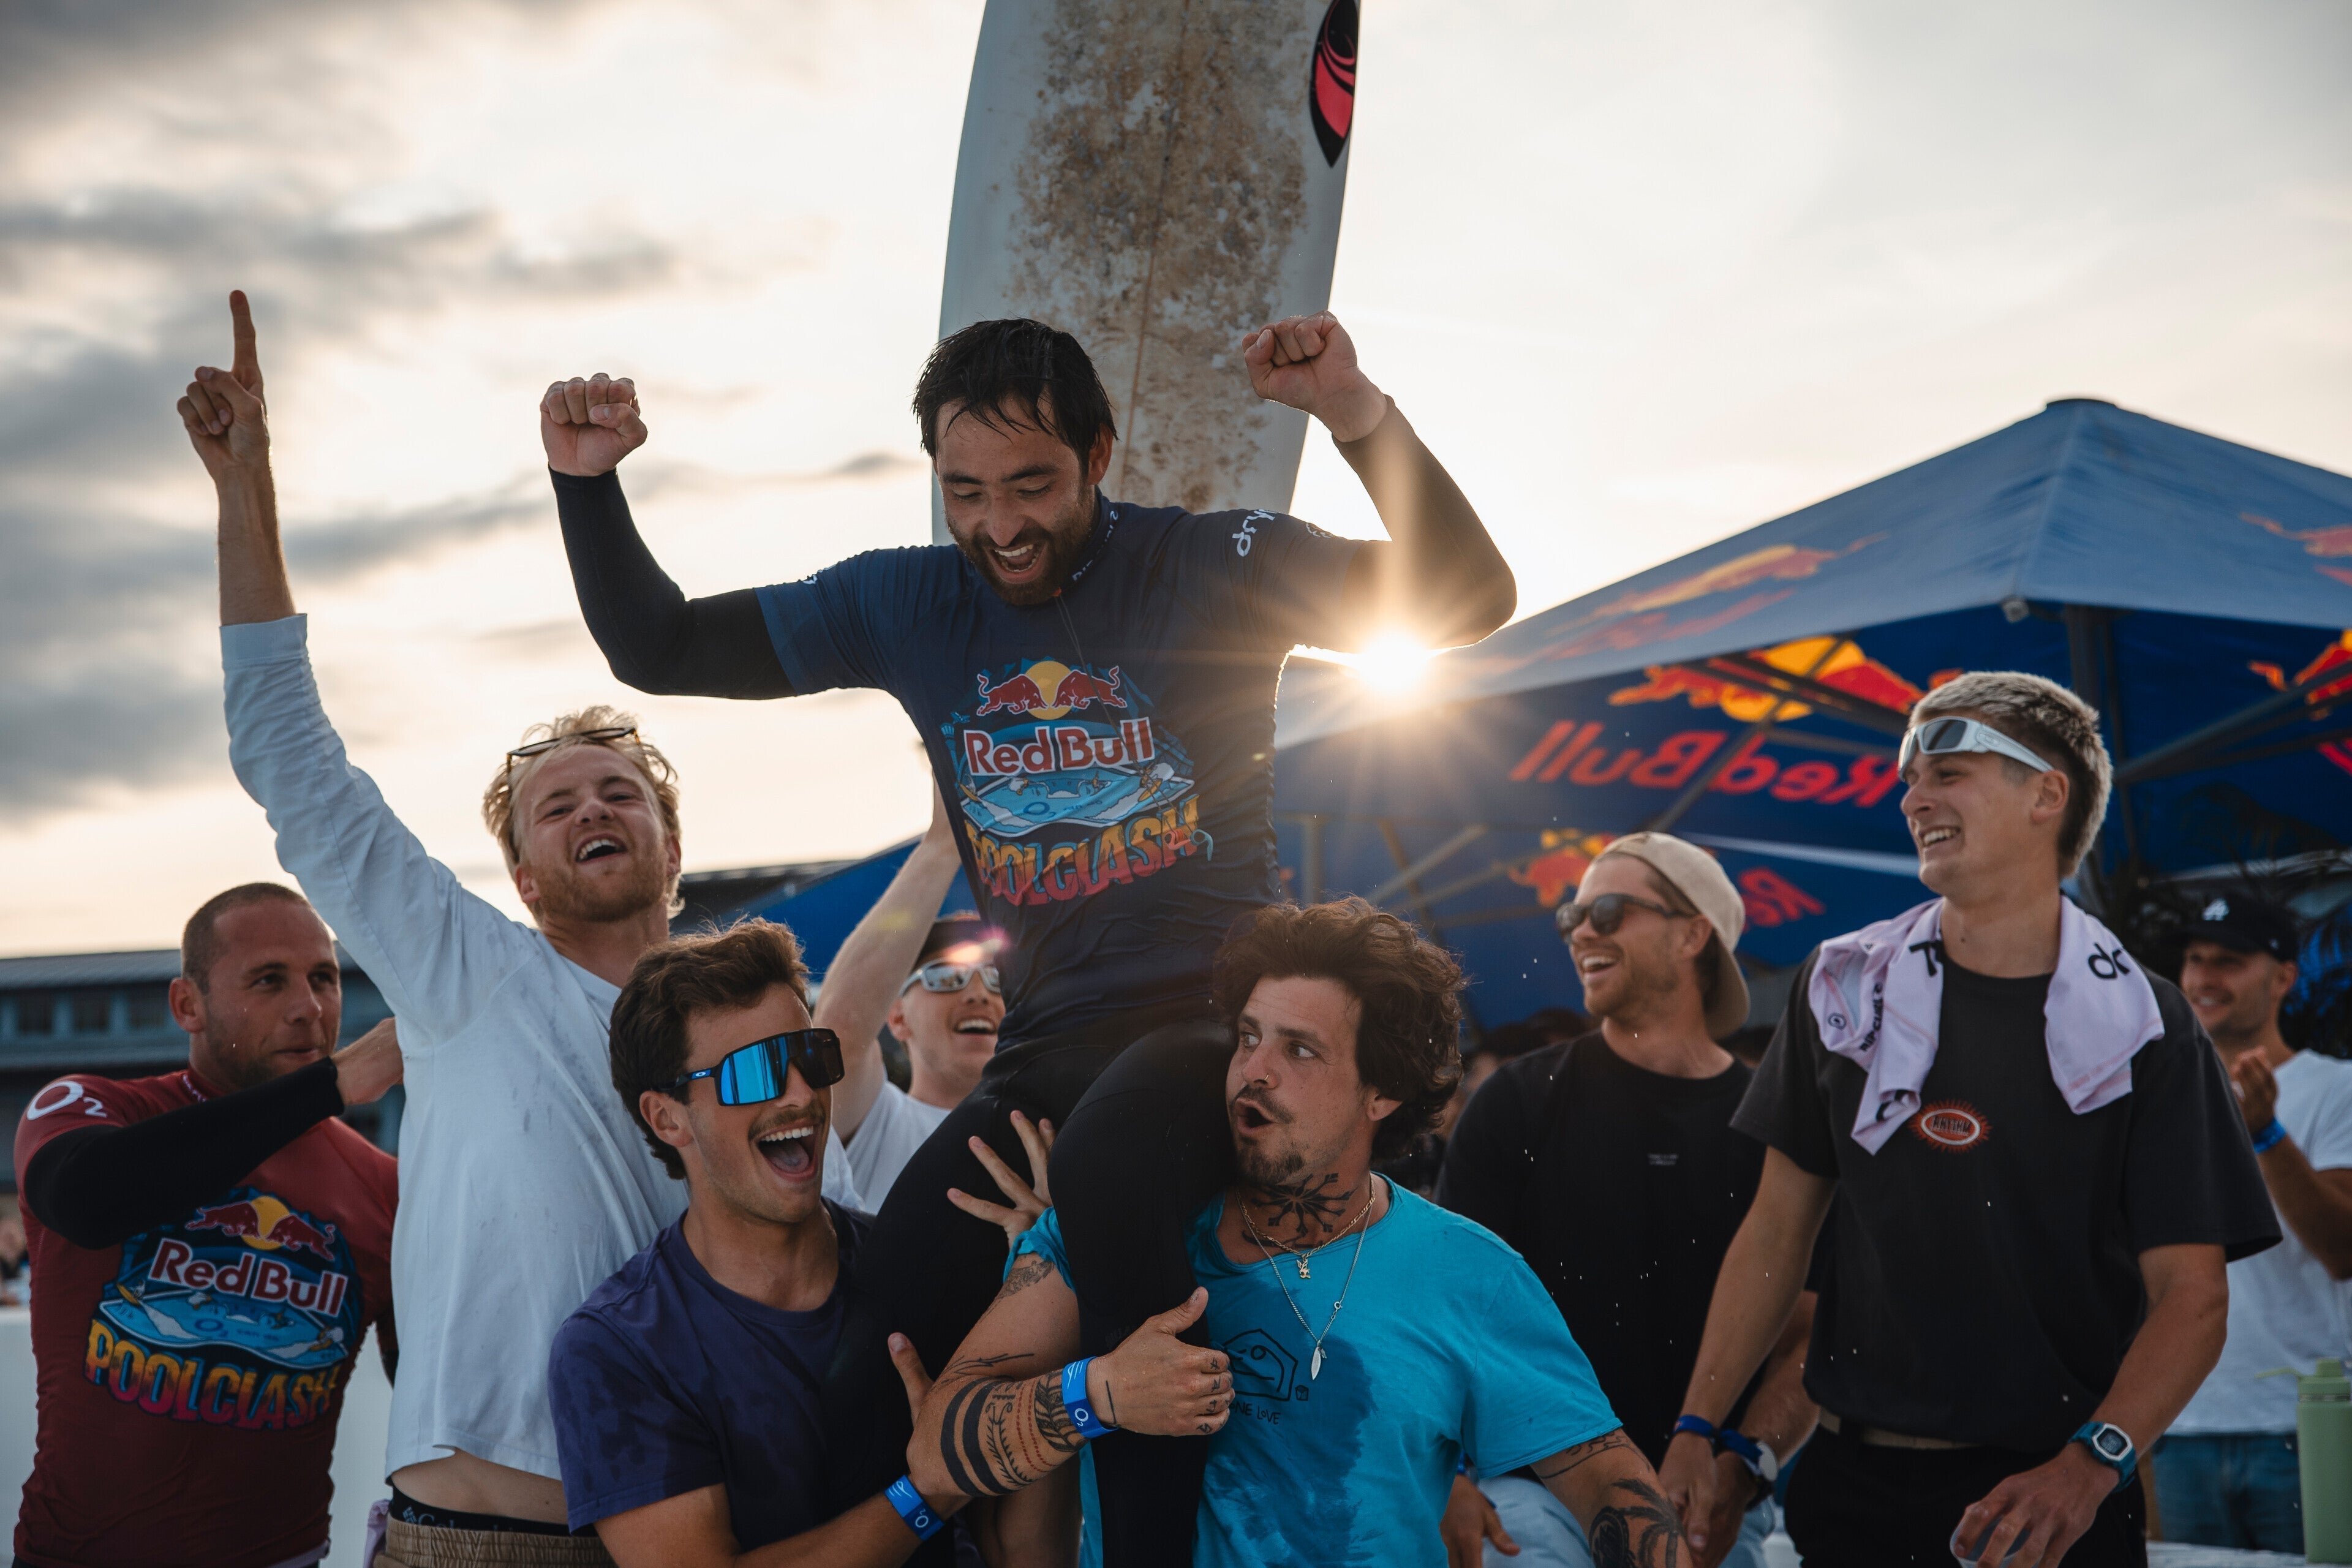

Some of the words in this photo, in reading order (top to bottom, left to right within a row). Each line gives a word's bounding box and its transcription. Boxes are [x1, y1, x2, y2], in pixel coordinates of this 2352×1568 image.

[964, 726, 1055, 776] Red
[1055, 717, 1155, 771] Bull
[27, 1080, 107, 1120] O2
[148, 1238, 255, 1294] Red
[252, 1261, 347, 1317] Bull
